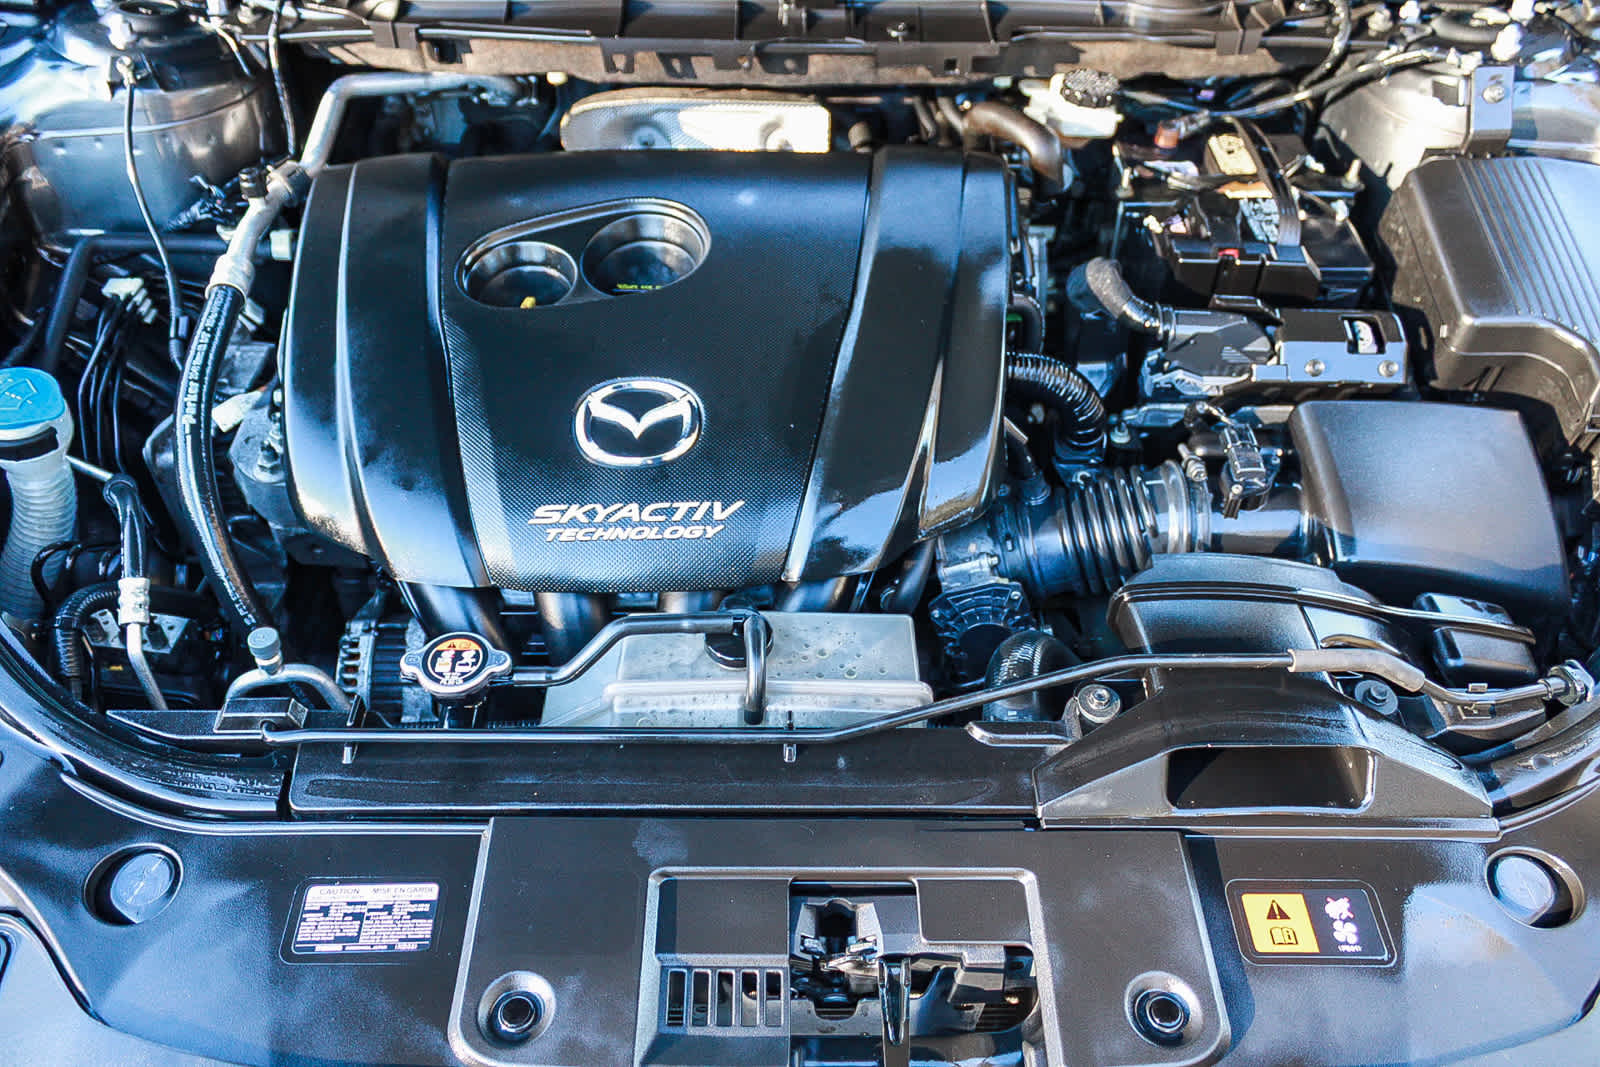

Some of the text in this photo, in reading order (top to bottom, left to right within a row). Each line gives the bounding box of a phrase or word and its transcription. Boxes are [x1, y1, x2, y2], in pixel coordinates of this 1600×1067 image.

[182, 381, 200, 425] Parker
[528, 500, 745, 524] SKYACTIV
[545, 525, 725, 542] TECHNOLOGY
[319, 887, 360, 895] CAUTION
